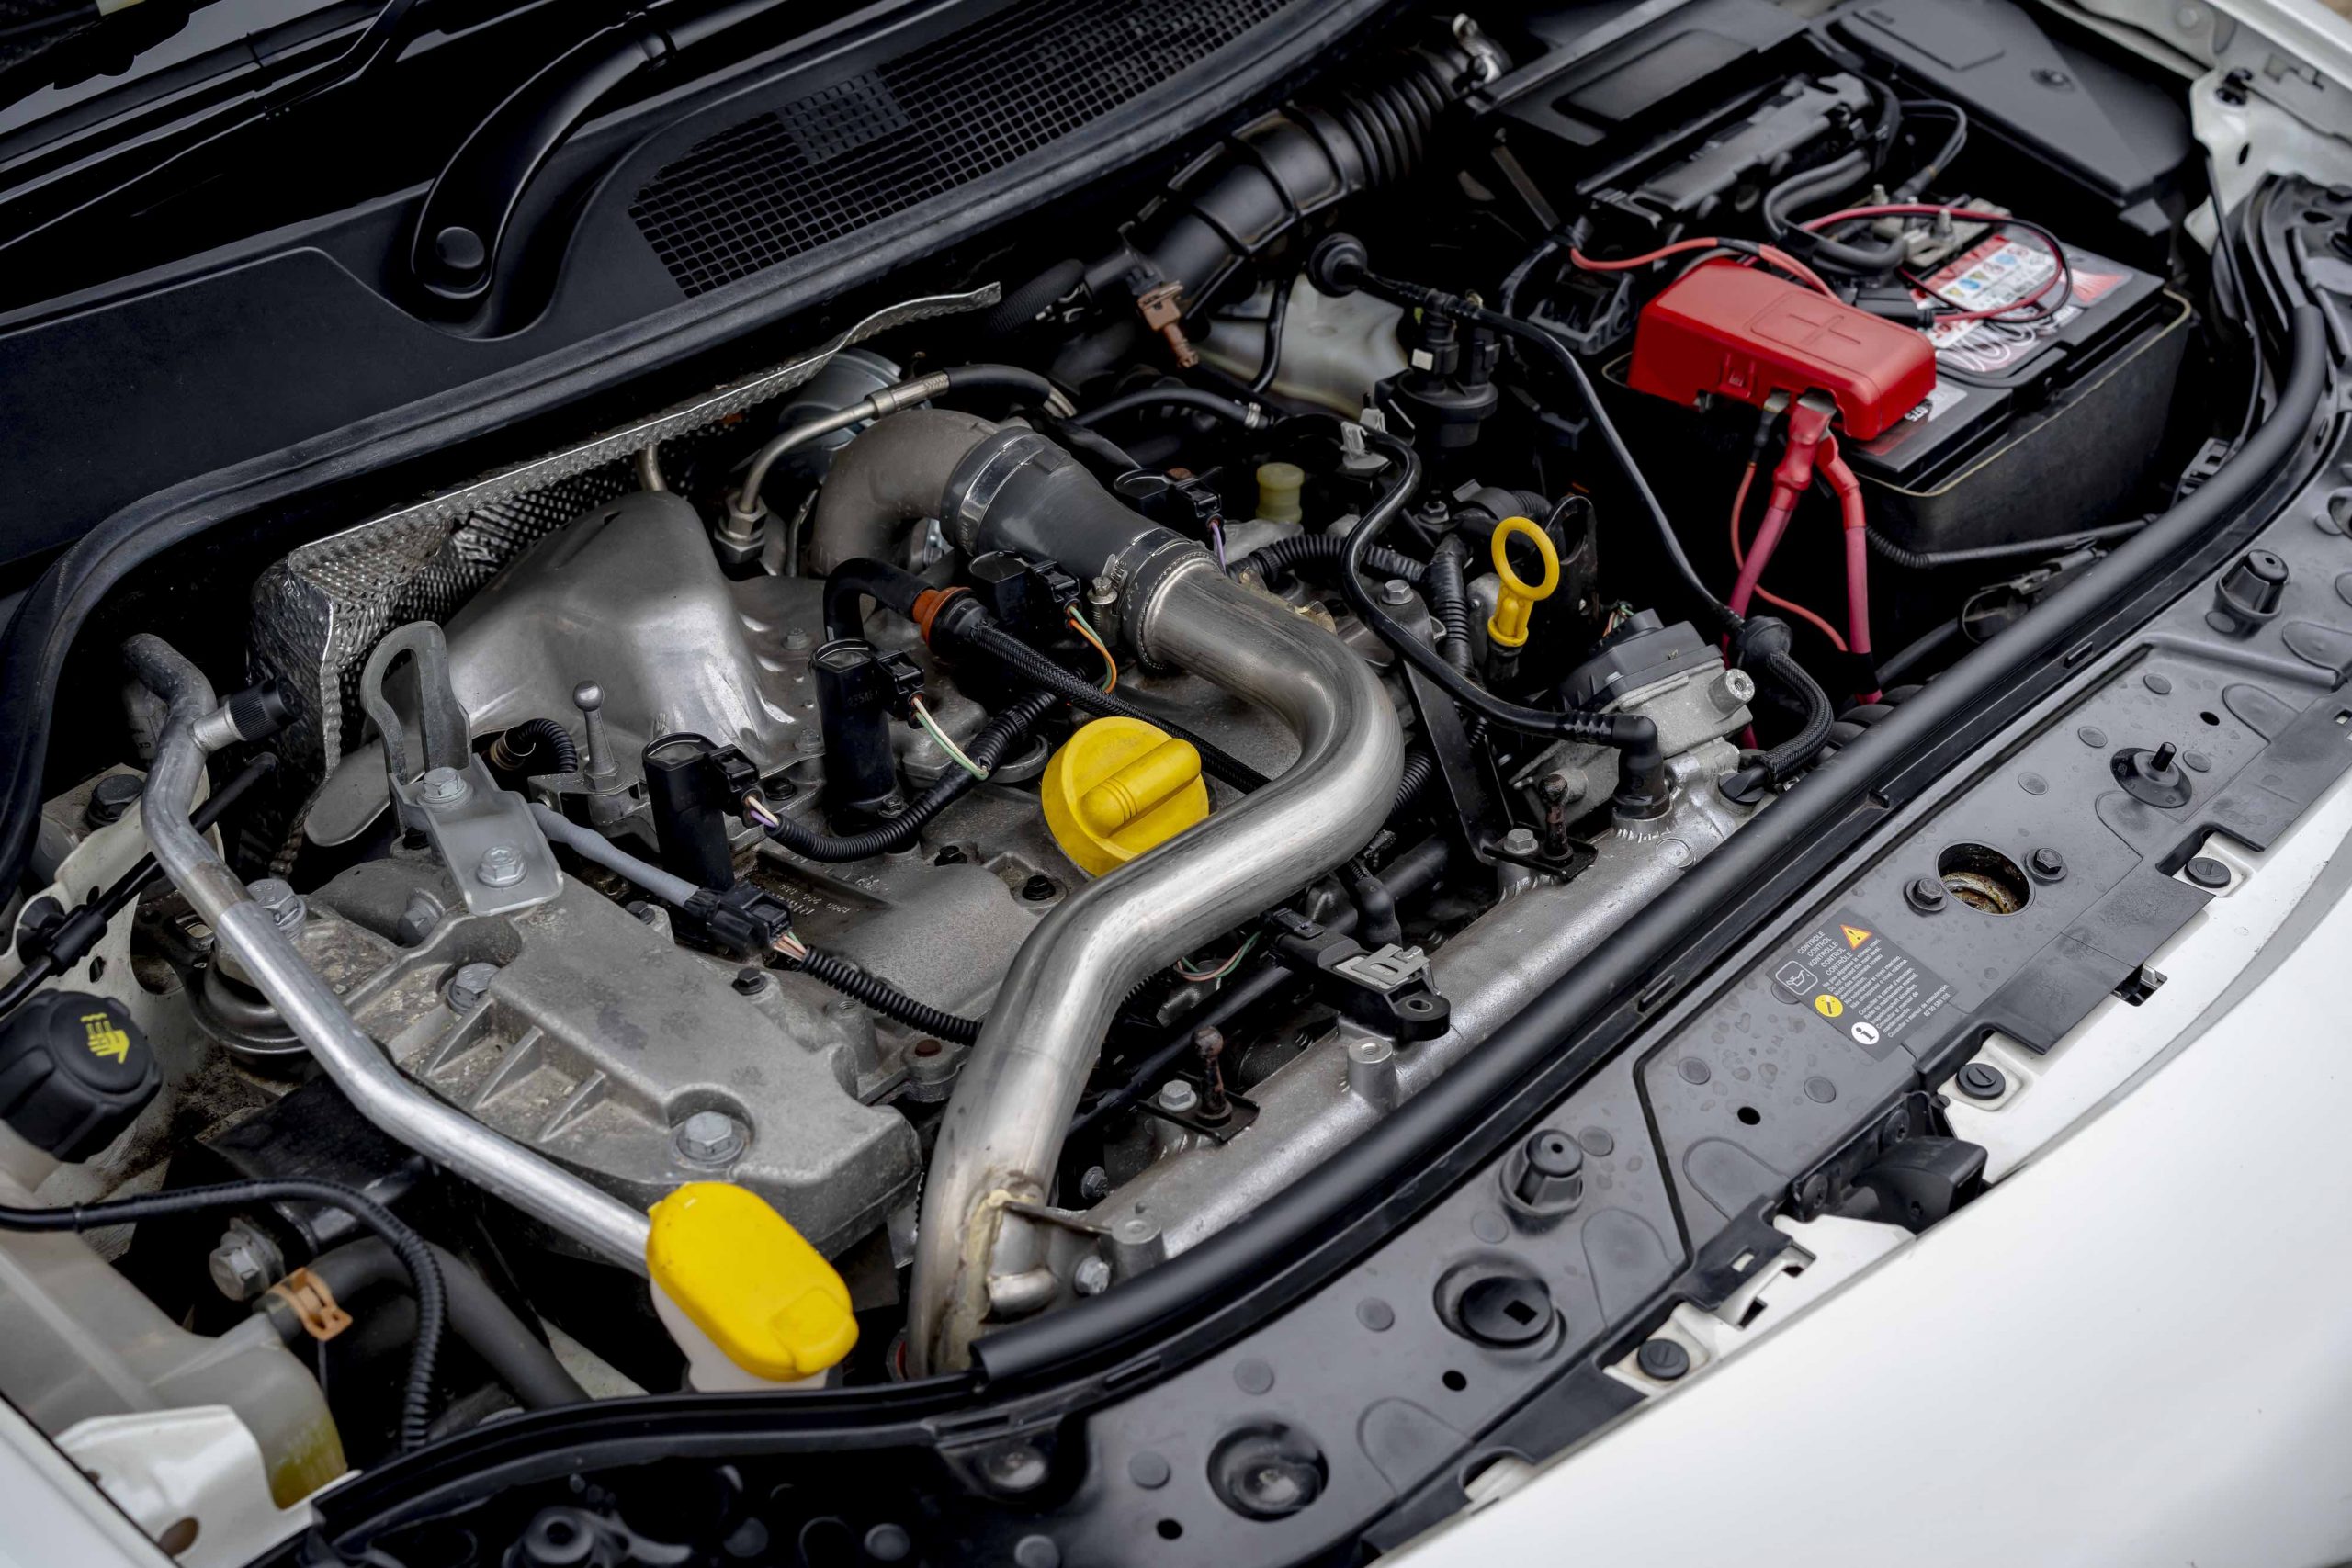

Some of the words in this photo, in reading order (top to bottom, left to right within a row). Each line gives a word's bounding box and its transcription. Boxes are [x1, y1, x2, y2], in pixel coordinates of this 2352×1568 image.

[1797, 931, 1825, 954] CONTROLE
[1807, 937, 1832, 956] CONTROL
[1808, 942, 1838, 966] KONTROLLE
[1821, 948, 1846, 967] CONTROL
[1841, 967, 1856, 981] exceed
[1863, 1010, 1876, 1020] Refer
